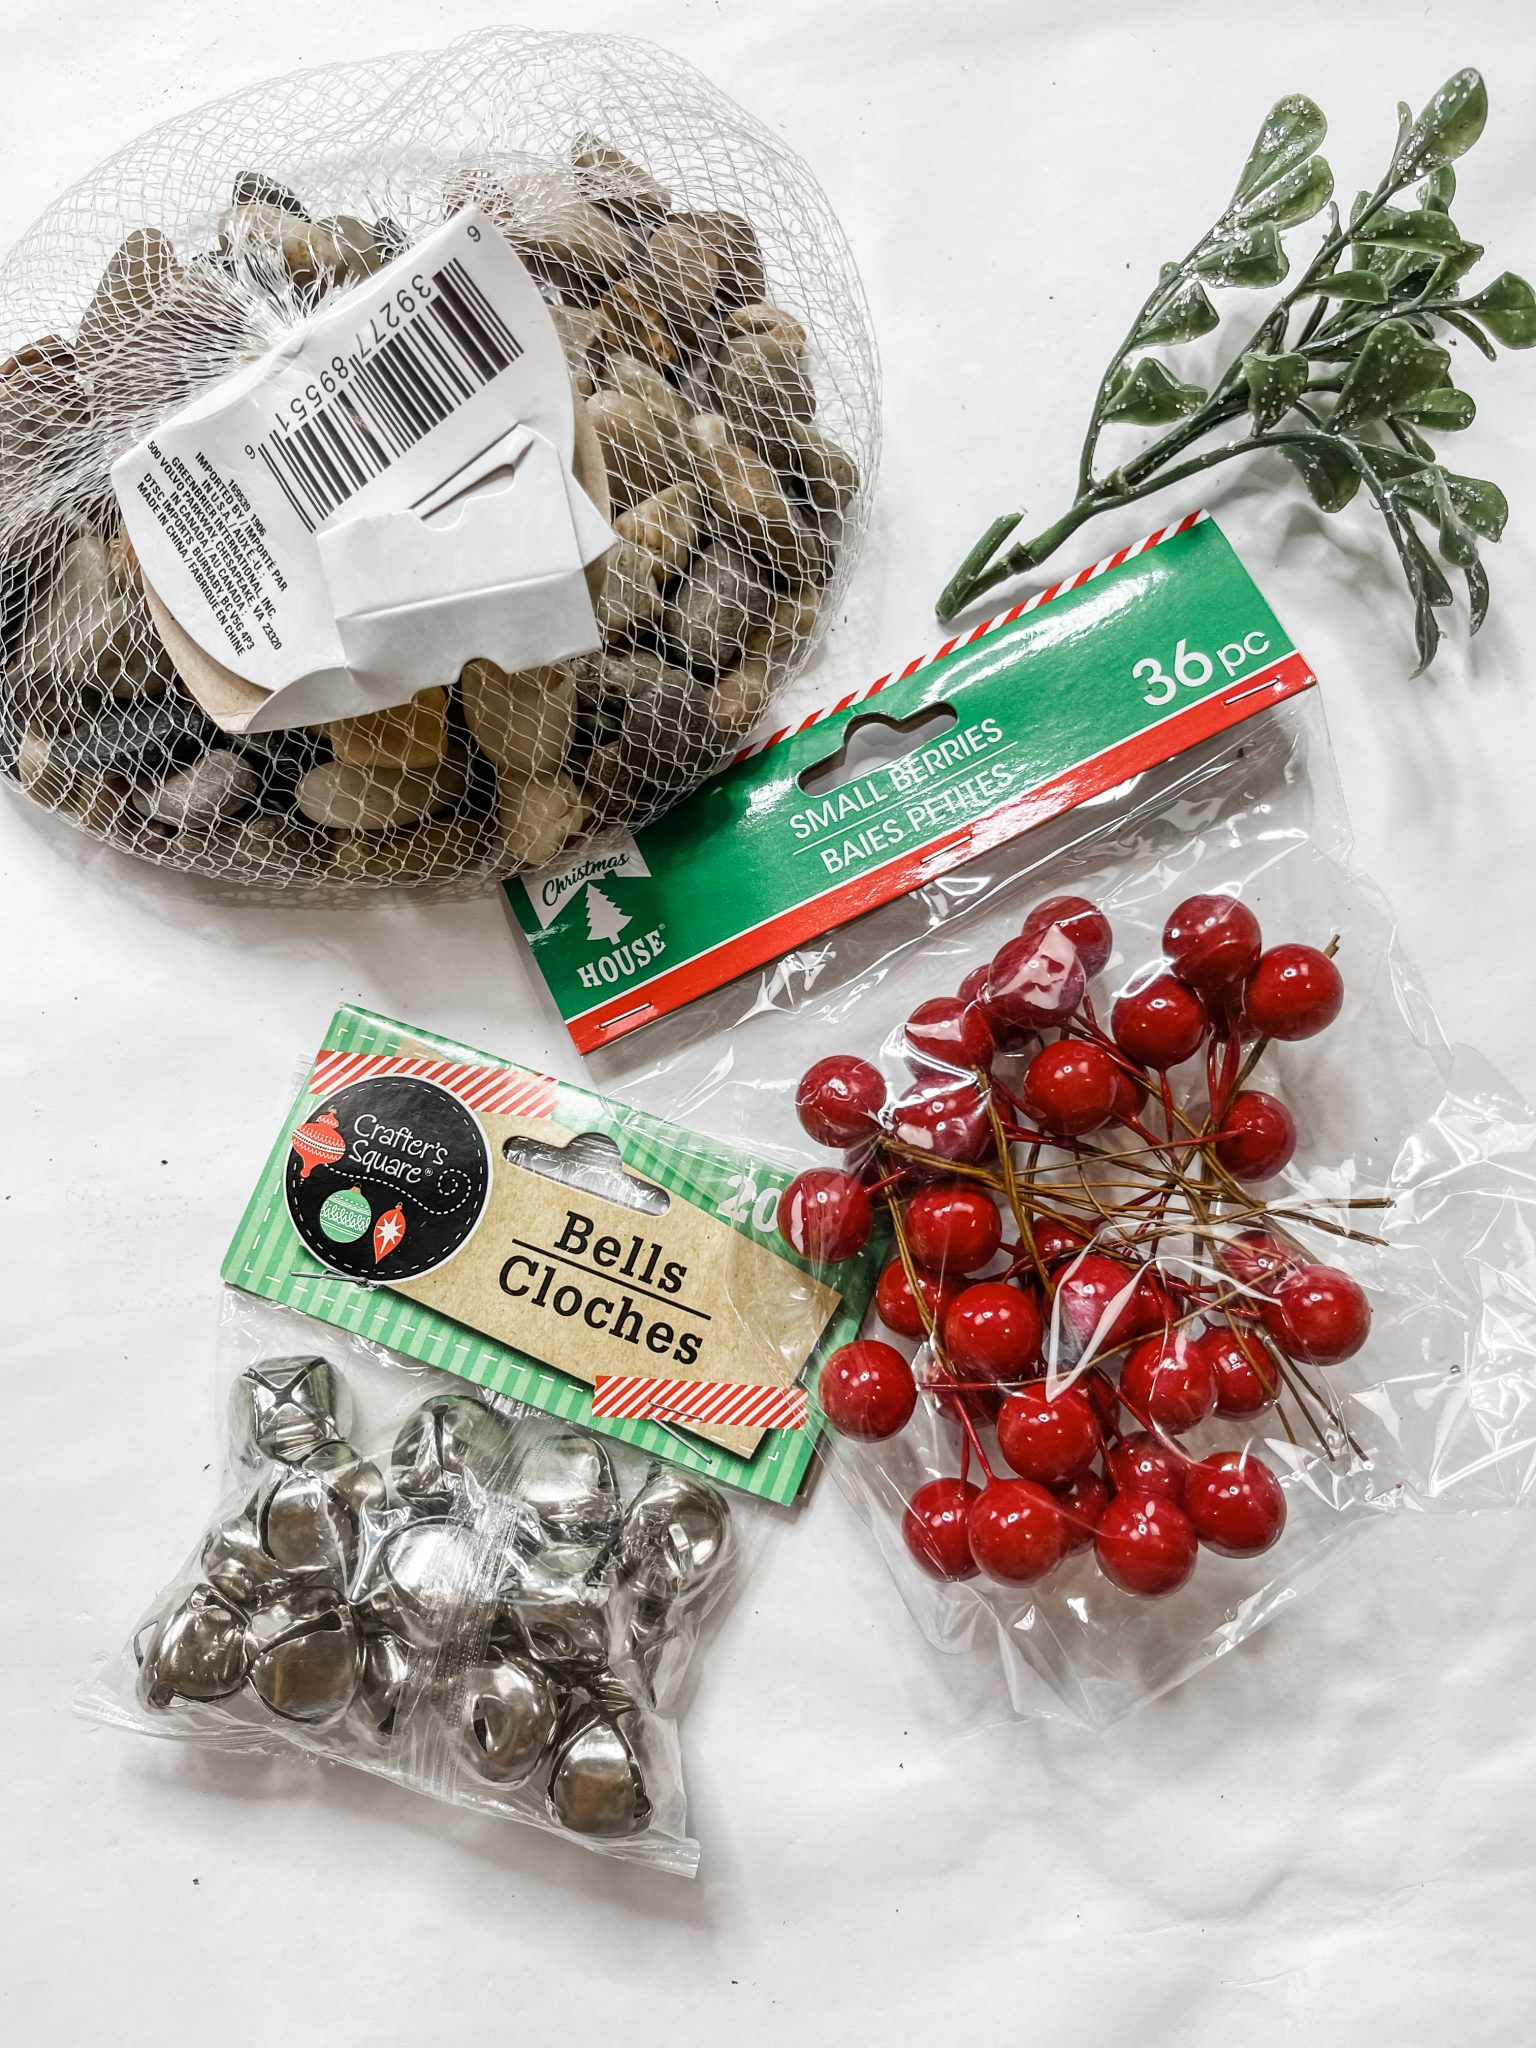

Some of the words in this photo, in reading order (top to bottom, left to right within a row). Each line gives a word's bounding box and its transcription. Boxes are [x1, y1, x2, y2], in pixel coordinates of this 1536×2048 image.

[355, 274, 432, 359] 39277
[274, 356, 349, 433] 89551
[147, 440, 161, 459] 500
[159, 456, 184, 491] VOLVO
[252, 604, 264, 621] VA
[262, 622, 282, 650] 23320
[169, 491, 181, 505] IN
[178, 504, 208, 548] CANADA
[208, 553, 221, 568] AU
[218, 567, 245, 611] CANADA
[171, 456, 216, 519] GREENBRIER
[260, 596, 276, 619] INC.
[194, 451, 233, 504] IMPORTED
[231, 503, 244, 519] BY
[244, 524, 276, 571] IMPORTÉ
[271, 568, 287, 591] PAR
[201, 478, 213, 494] IN
[210, 491, 230, 523] U.S.A.
[232, 528, 250, 550] AUX
[227, 478, 250, 512] 169539
[250, 513, 266, 536] 1906
[136, 481, 160, 514] MADE
[156, 511, 169, 526] IN
[165, 524, 188, 558] CHINA
[215, 608, 228, 625] EN
[224, 624, 245, 656] CHINE
[143, 472, 164, 500] DTSC
[161, 498, 194, 545] IMPORTS
[219, 595, 233, 611] BC
[229, 609, 244, 631] V5G
[241, 631, 254, 649] 4P3
[1132, 638, 1213, 706] 36
[1216, 631, 1270, 678] pc
[789, 779, 888, 839] SMALL
[888, 718, 1003, 792] BERRIES
[820, 818, 904, 874] BAIES
[905, 763, 1014, 832] PETITES
[542, 853, 630, 906] Christmas
[354, 1114, 448, 1165] Crafter's
[553, 1210, 688, 1293] Bells
[716, 1174, 783, 1233] 20
[499, 1255, 703, 1365] Cloches
